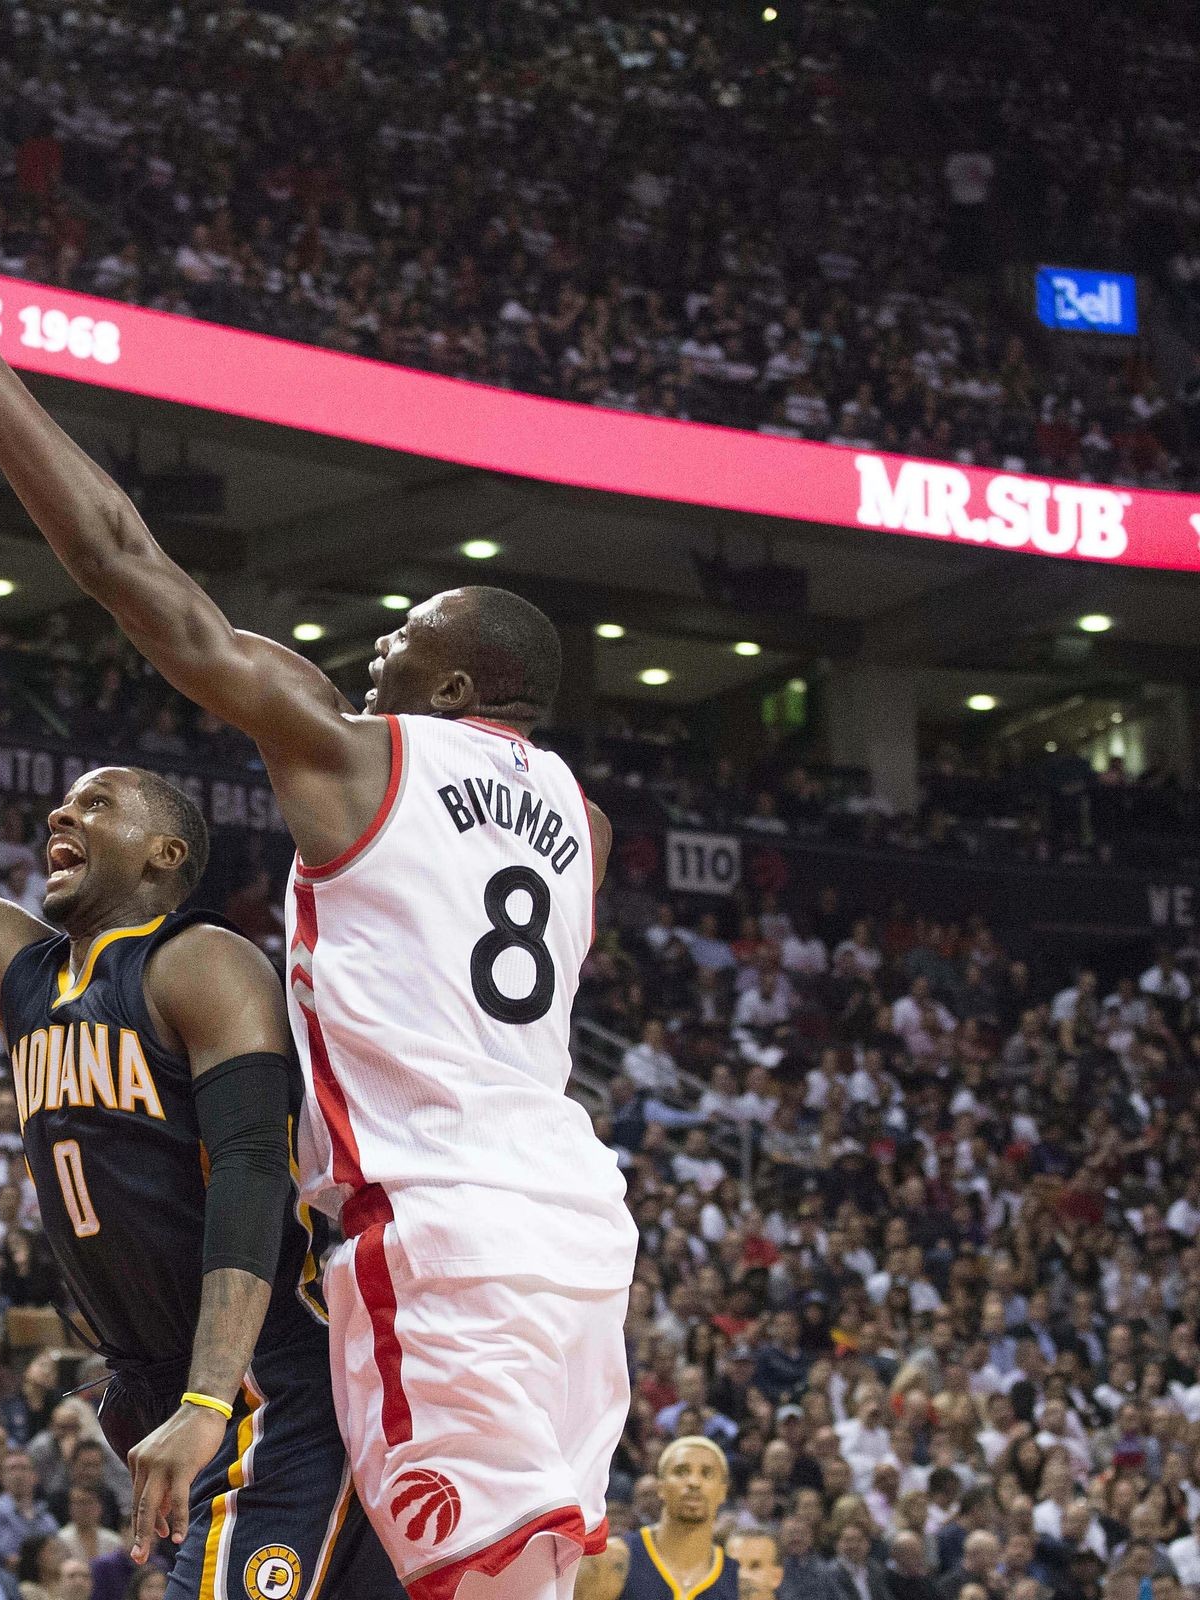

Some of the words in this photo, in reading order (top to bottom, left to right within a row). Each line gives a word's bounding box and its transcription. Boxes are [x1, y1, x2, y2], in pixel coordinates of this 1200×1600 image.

[17, 305, 121, 365] 1968
[1051, 276, 1122, 325] Bell
[854, 454, 1129, 559] MR.SUB
[437, 777, 580, 875] BIYOMBO
[677, 843, 735, 881] 110
[470, 865, 556, 1025] 8
[11, 1021, 167, 1138] NDIANA
[52, 1138, 101, 1238] 0
